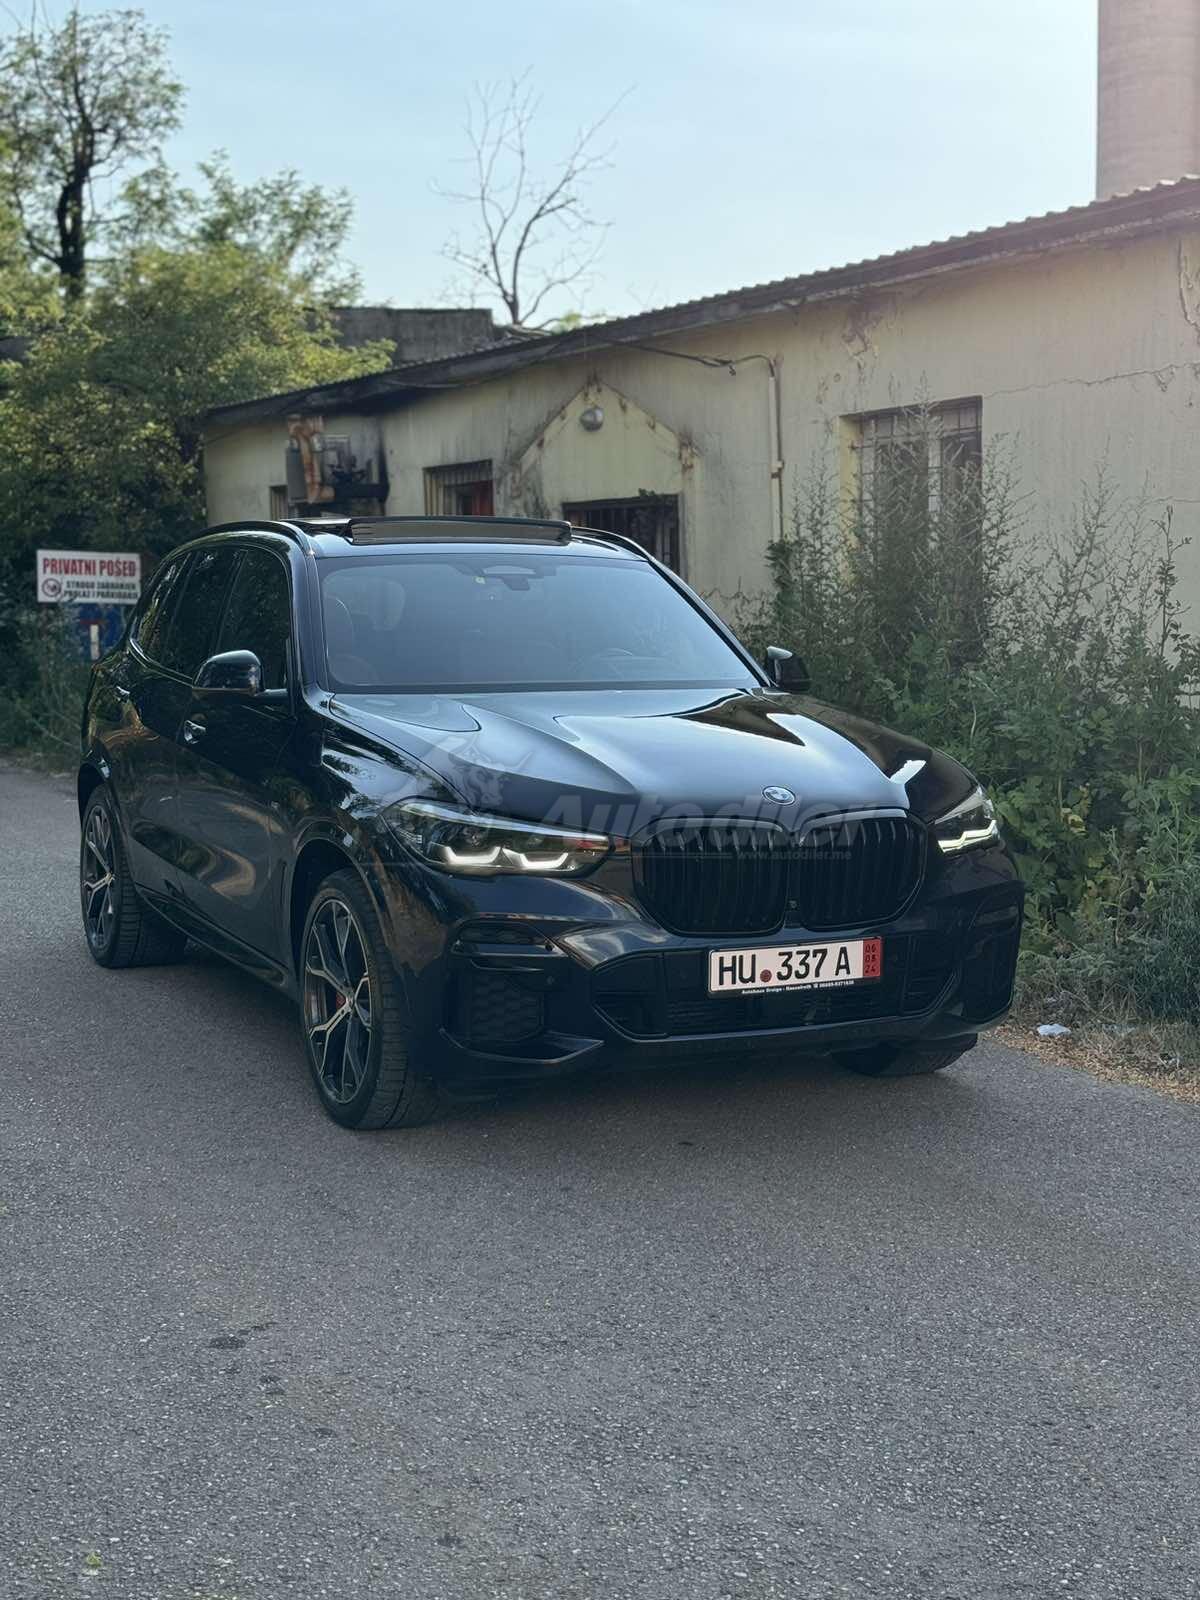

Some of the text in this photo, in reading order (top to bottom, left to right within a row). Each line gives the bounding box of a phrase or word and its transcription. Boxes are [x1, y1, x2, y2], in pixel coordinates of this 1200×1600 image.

[43, 557, 97, 576] PRIVATNI
[718, 946, 851, 986] HU 337 A
